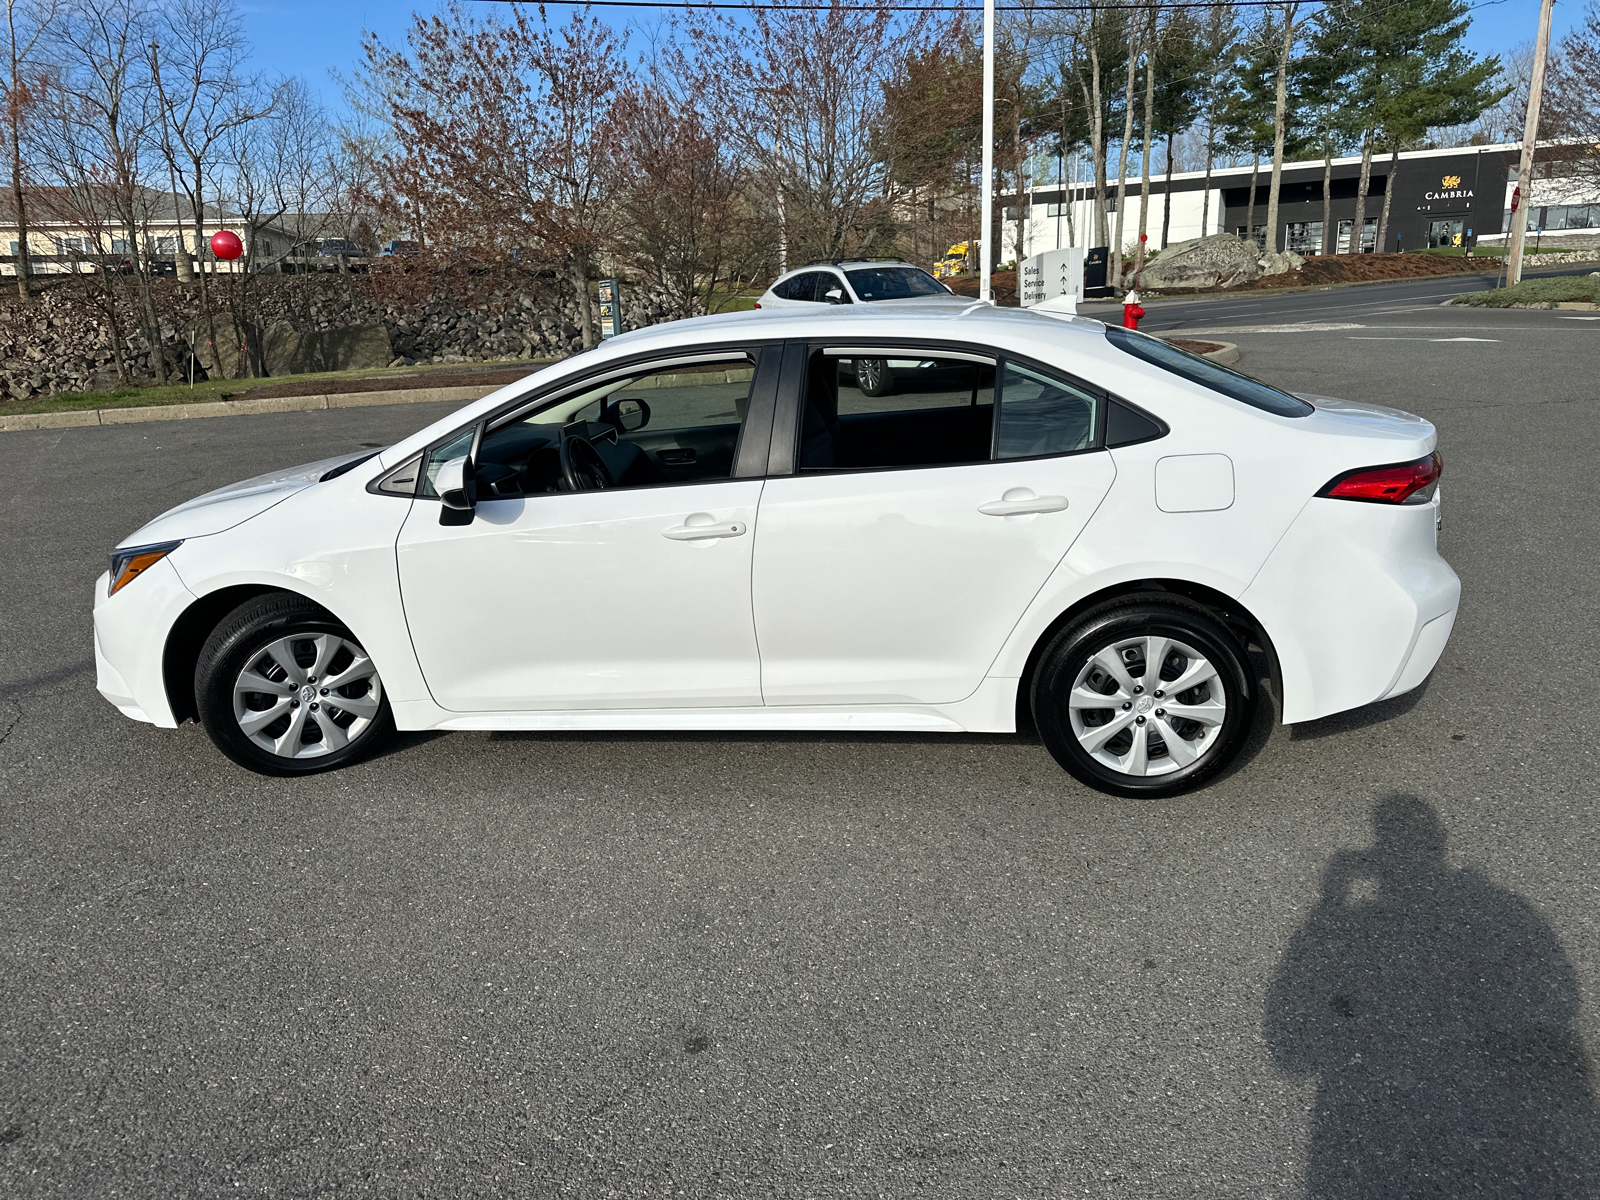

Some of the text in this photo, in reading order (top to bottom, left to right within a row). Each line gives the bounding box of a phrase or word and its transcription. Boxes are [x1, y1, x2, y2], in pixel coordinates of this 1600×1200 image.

[1425, 190, 1474, 200] CAMBRIA
[1024, 266, 1040, 276] Sales
[1024, 278, 1045, 288] Service
[1024, 291, 1047, 301] Delivery
